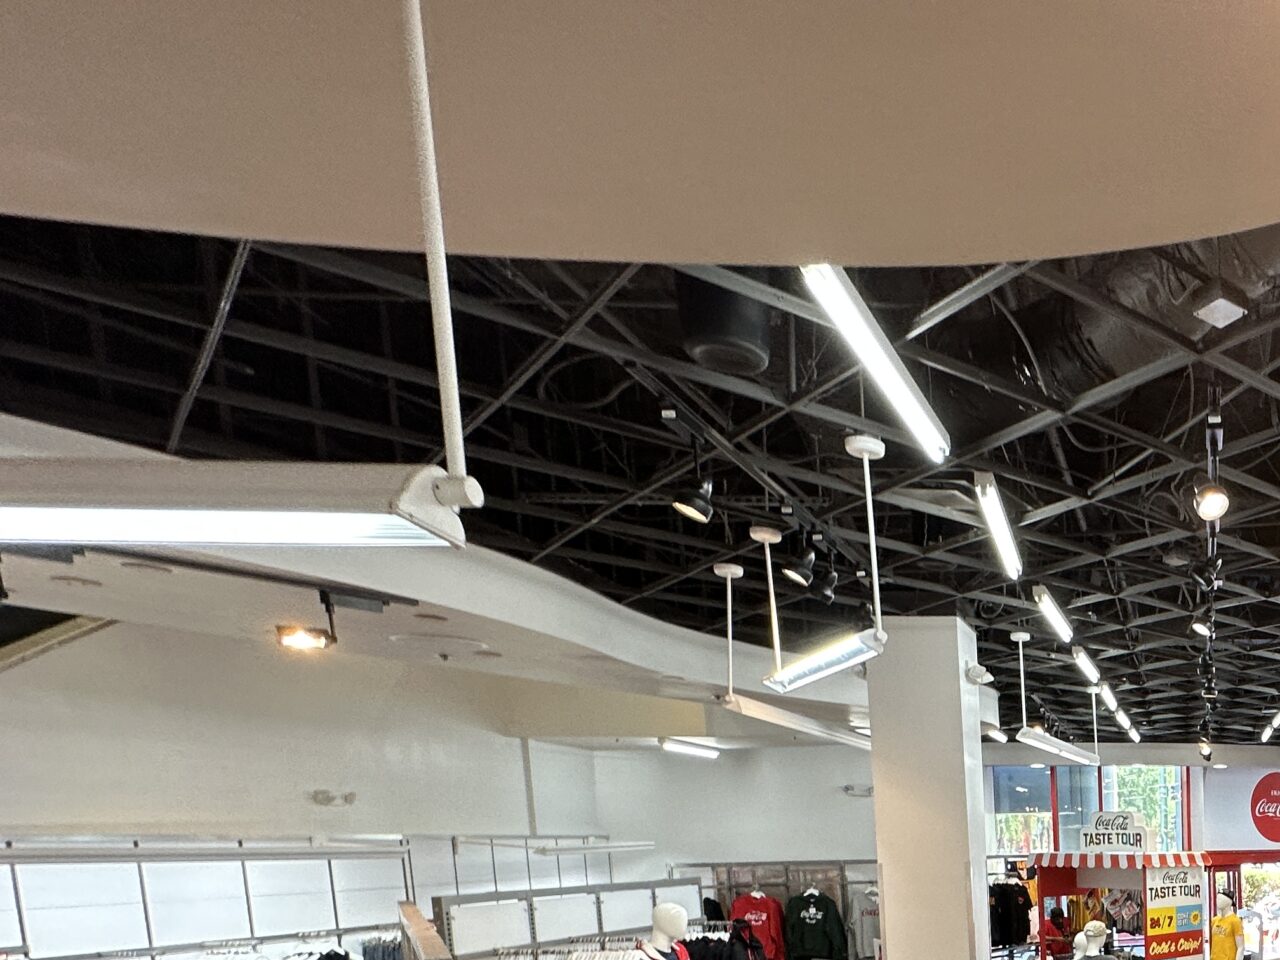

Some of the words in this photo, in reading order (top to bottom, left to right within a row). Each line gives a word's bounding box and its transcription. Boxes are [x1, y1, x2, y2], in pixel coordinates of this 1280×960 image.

[1095, 815, 1129, 831] Coca-Cola
[1083, 833, 1113, 848] TASTE
[1116, 833, 1143, 848] TOUR
[1149, 886, 1177, 902] TASTE
[1179, 884, 1201, 899] TOUR
[1150, 914, 1174, 930] 24/7
[1149, 940, 1170, 956] Cold
[1177, 936, 1202, 954] Crisp!
